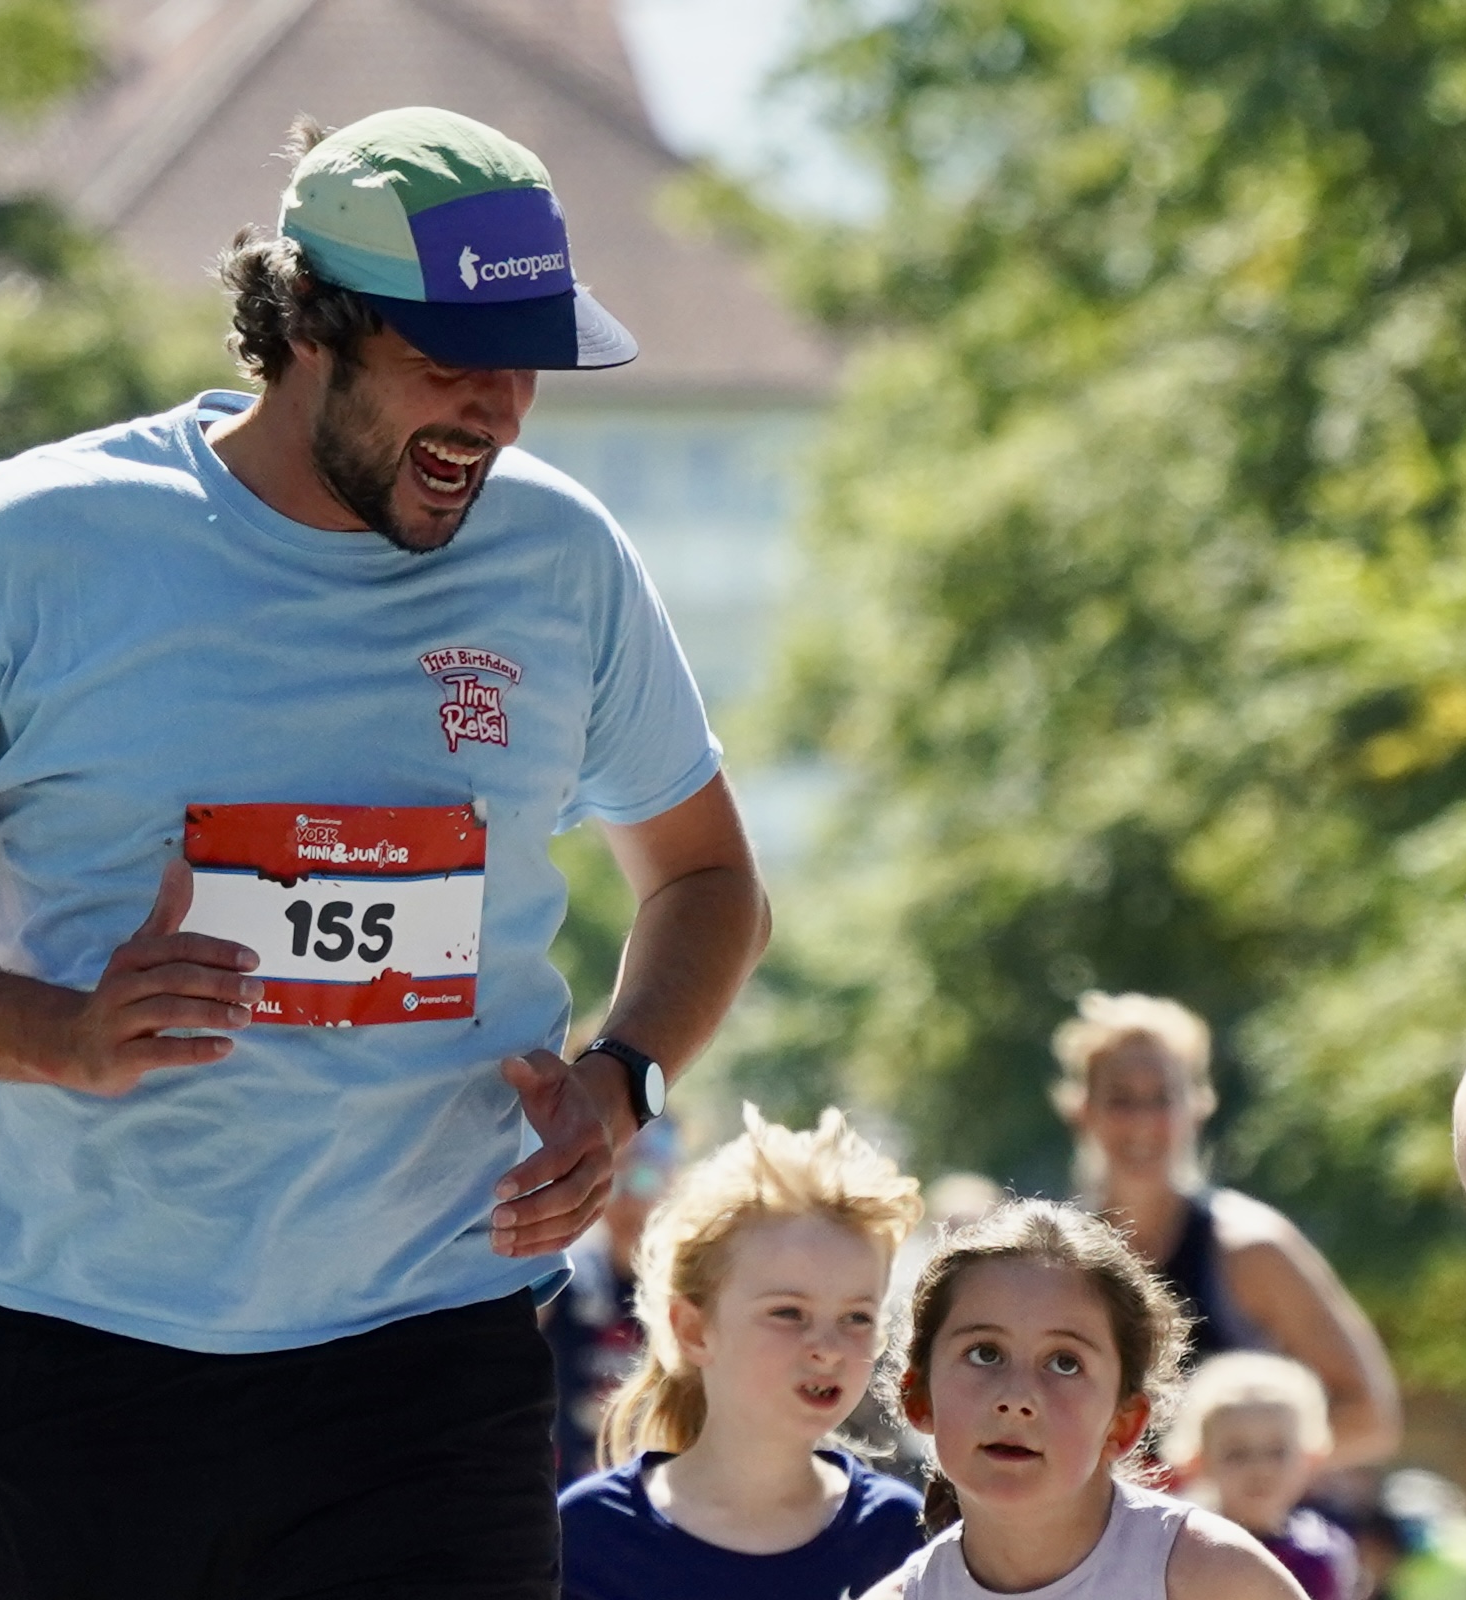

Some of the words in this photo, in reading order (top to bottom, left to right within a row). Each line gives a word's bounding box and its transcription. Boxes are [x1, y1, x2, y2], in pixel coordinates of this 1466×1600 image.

[480, 250, 566, 281] cotopaxi
[423, 650, 455, 672] 11th
[457, 650, 518, 680] Birthday
[442, 673, 501, 718] Tiny
[439, 701, 508, 753] Rebel
[296, 826, 338, 844] YORK
[285, 899, 395, 963] 155
[256, 1000, 283, 1015] ALL
